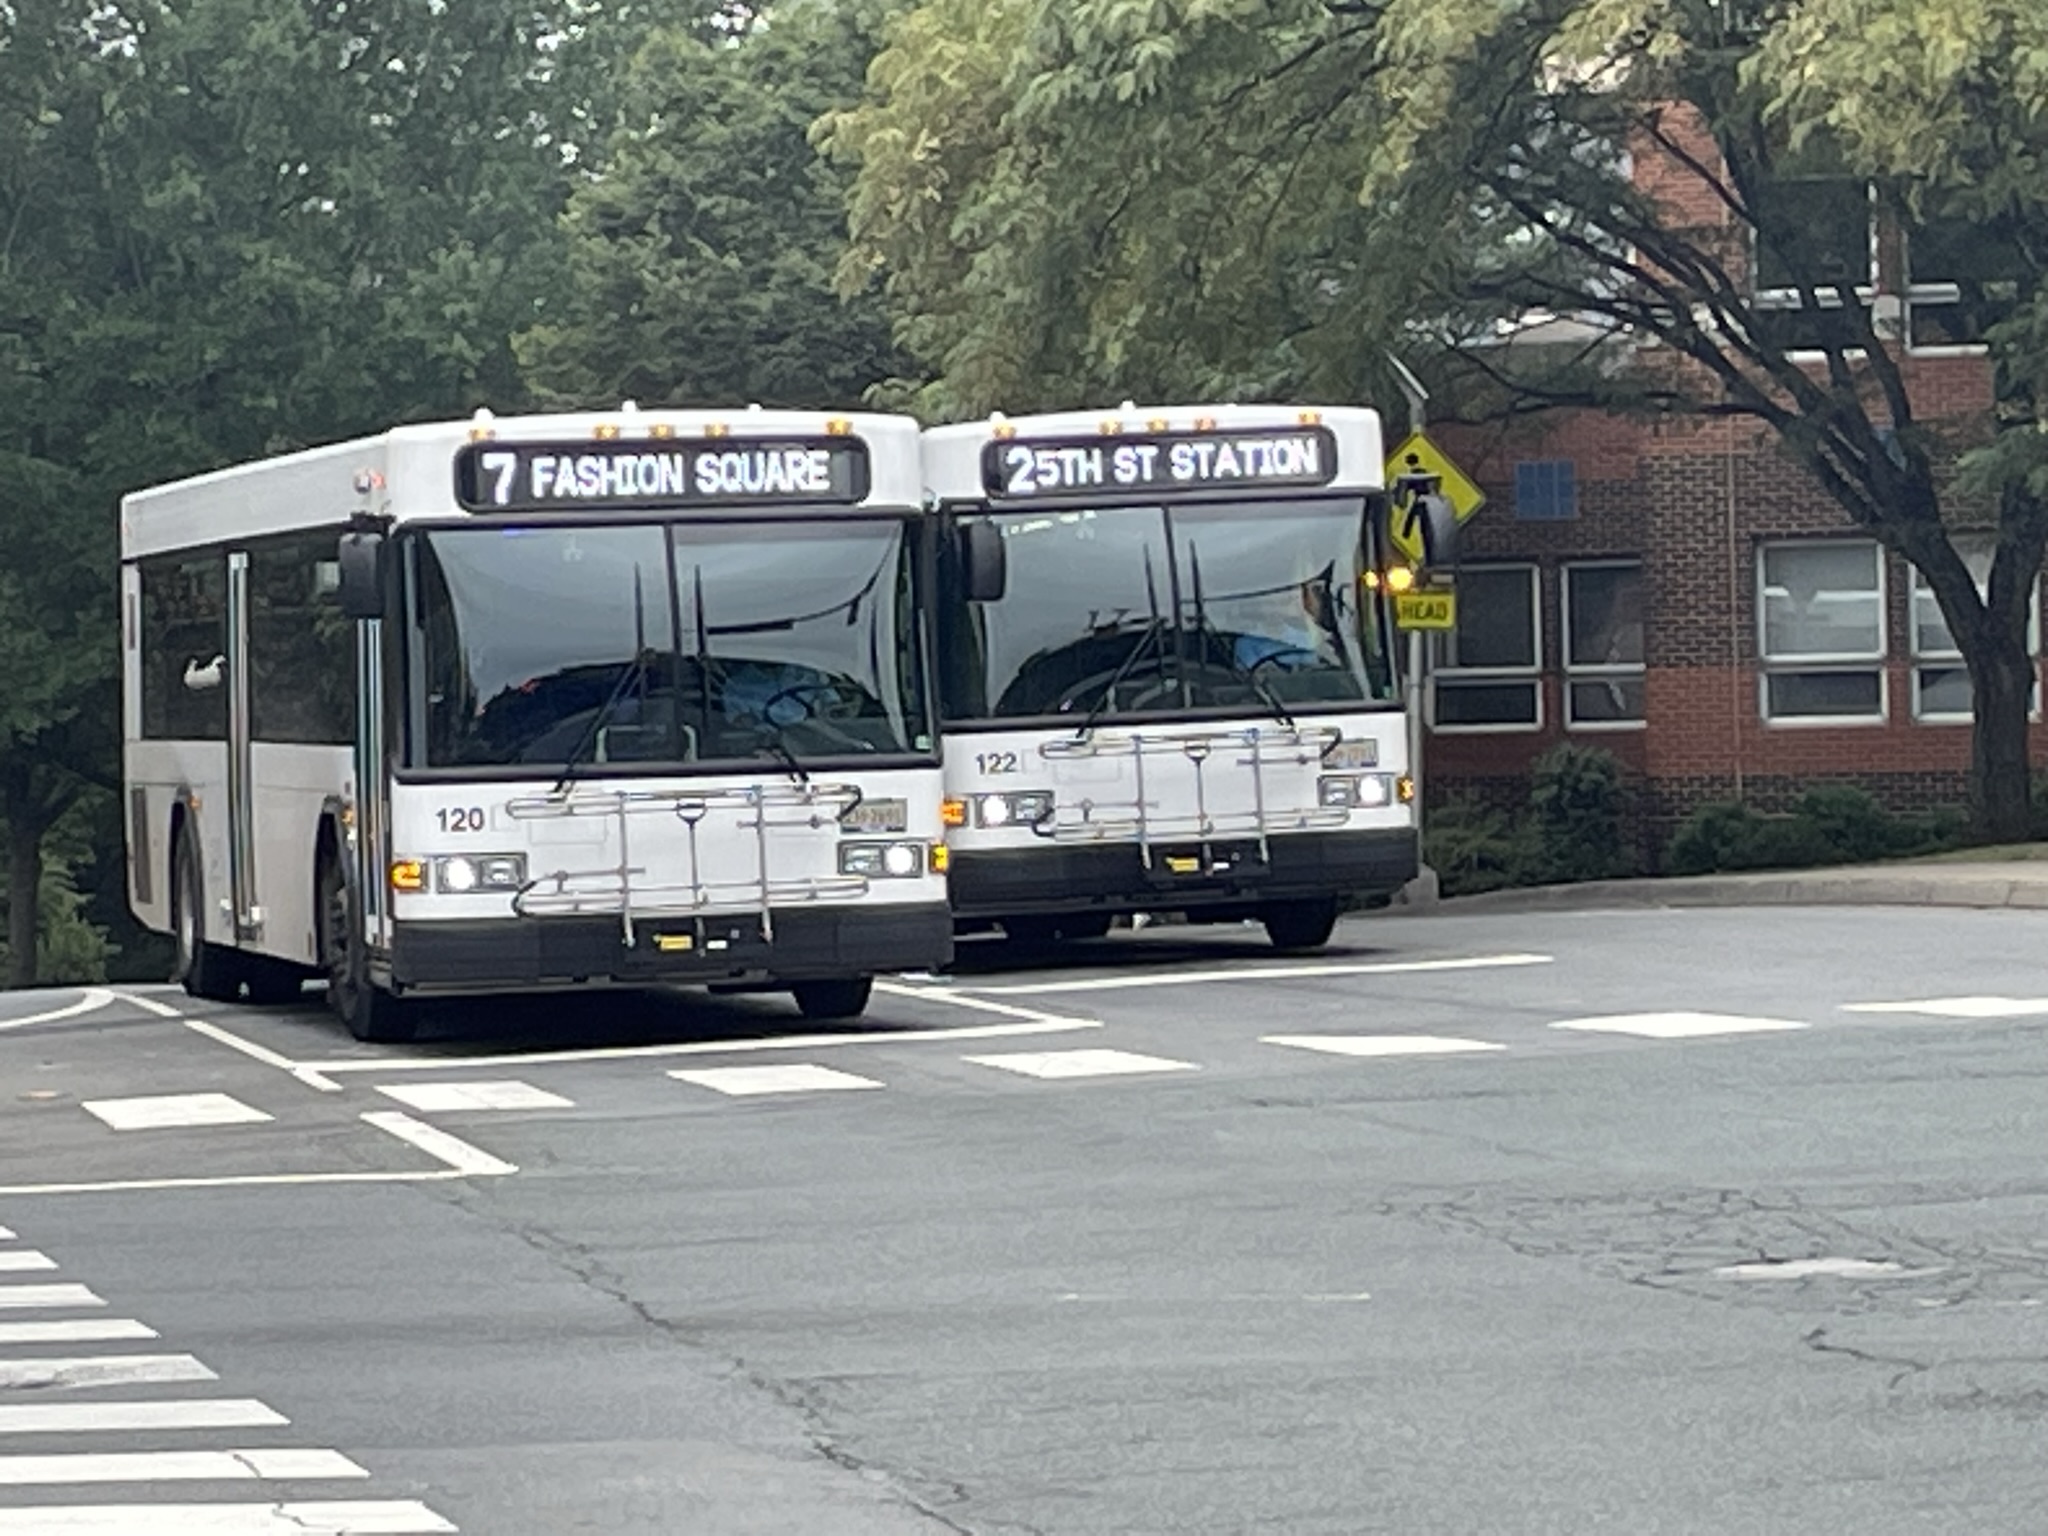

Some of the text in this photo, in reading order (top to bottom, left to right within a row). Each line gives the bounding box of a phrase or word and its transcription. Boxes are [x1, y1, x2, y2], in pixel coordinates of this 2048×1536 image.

[482, 450, 830, 505] 7 FASHION SQUARE
[1005, 438, 1318, 494] 25TH ST STATION
[1397, 600, 1448, 621] HEAD
[975, 753, 1017, 775] 122
[434, 806, 486, 833] 120
